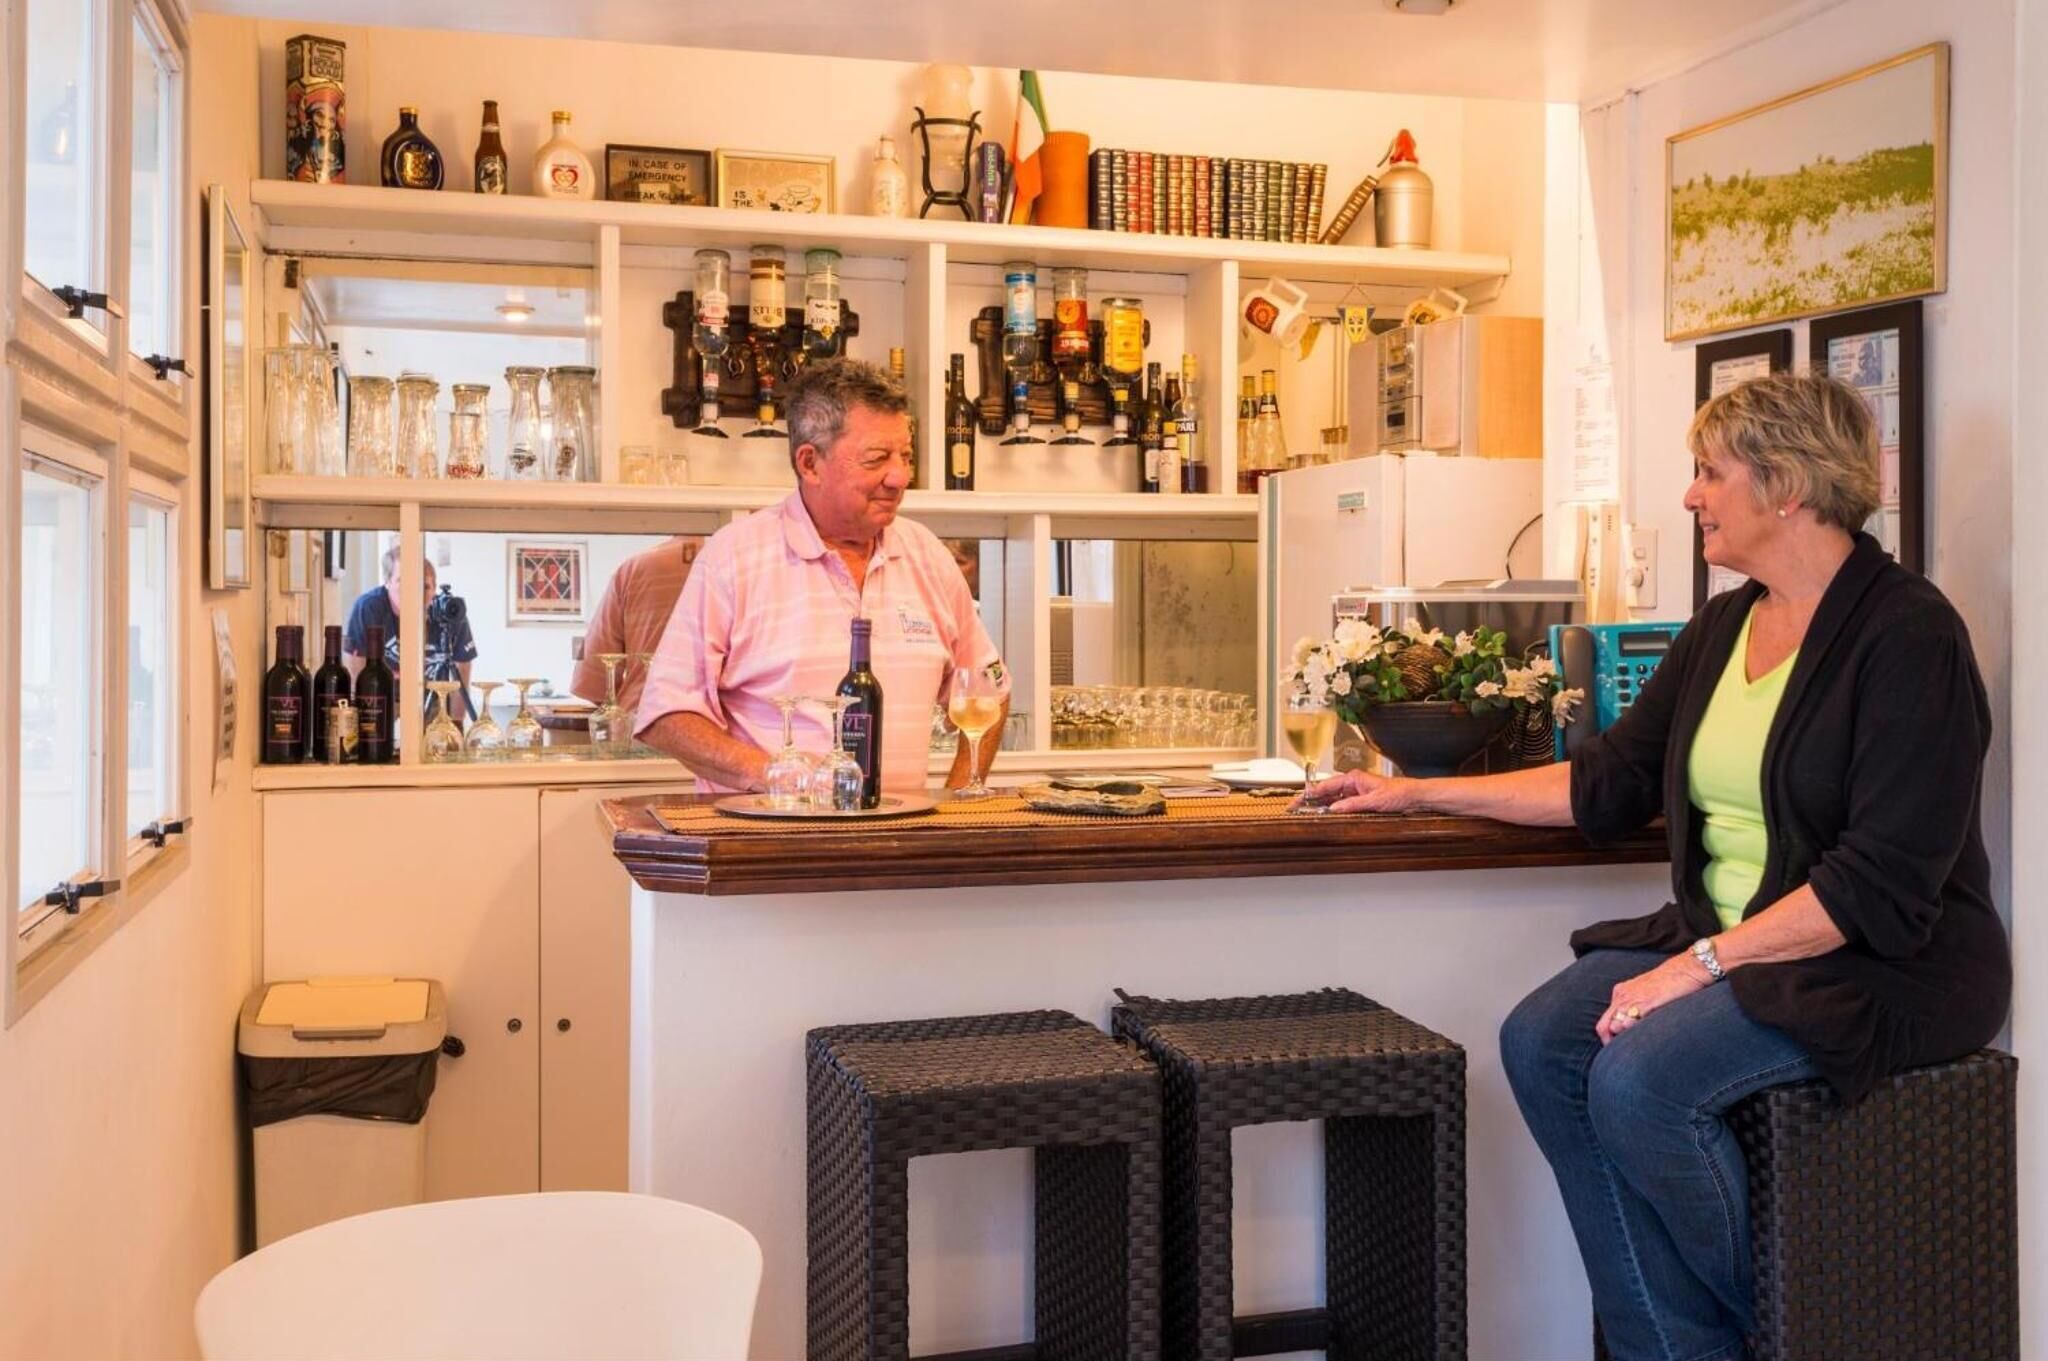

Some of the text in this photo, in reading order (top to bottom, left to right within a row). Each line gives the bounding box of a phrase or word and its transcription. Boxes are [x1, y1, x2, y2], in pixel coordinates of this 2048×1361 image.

[628, 159, 687, 171] IN CASE OF
[628, 171, 687, 182] EMERGENCY
[624, 191, 657, 201] BREAK
[734, 190, 746, 199] IS
[732, 199, 753, 208] THE
